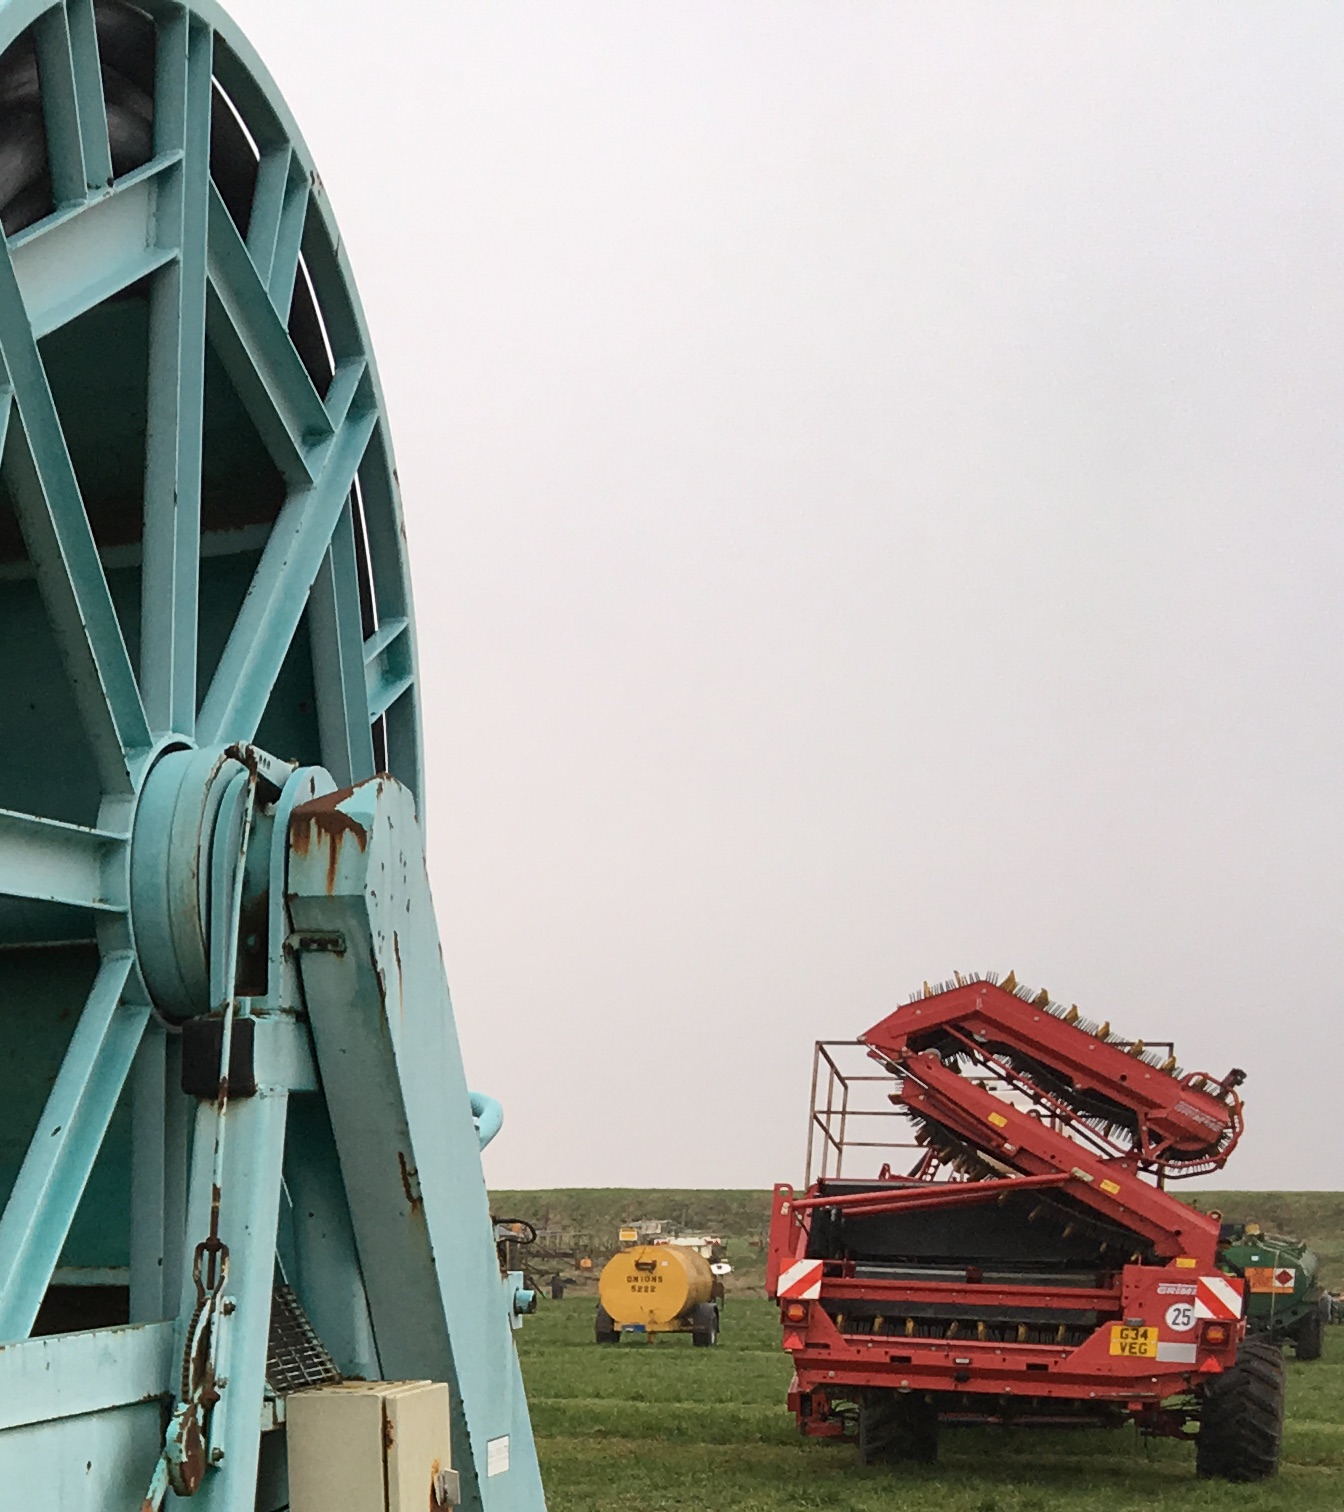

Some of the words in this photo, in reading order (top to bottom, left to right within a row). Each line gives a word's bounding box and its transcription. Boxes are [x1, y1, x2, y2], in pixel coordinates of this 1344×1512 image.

[1157, 1285, 1197, 1295] GRIM
[1172, 1308, 1191, 1326] 25
[1120, 1328, 1149, 1341] G34
[1120, 1342, 1148, 1354] VEG
